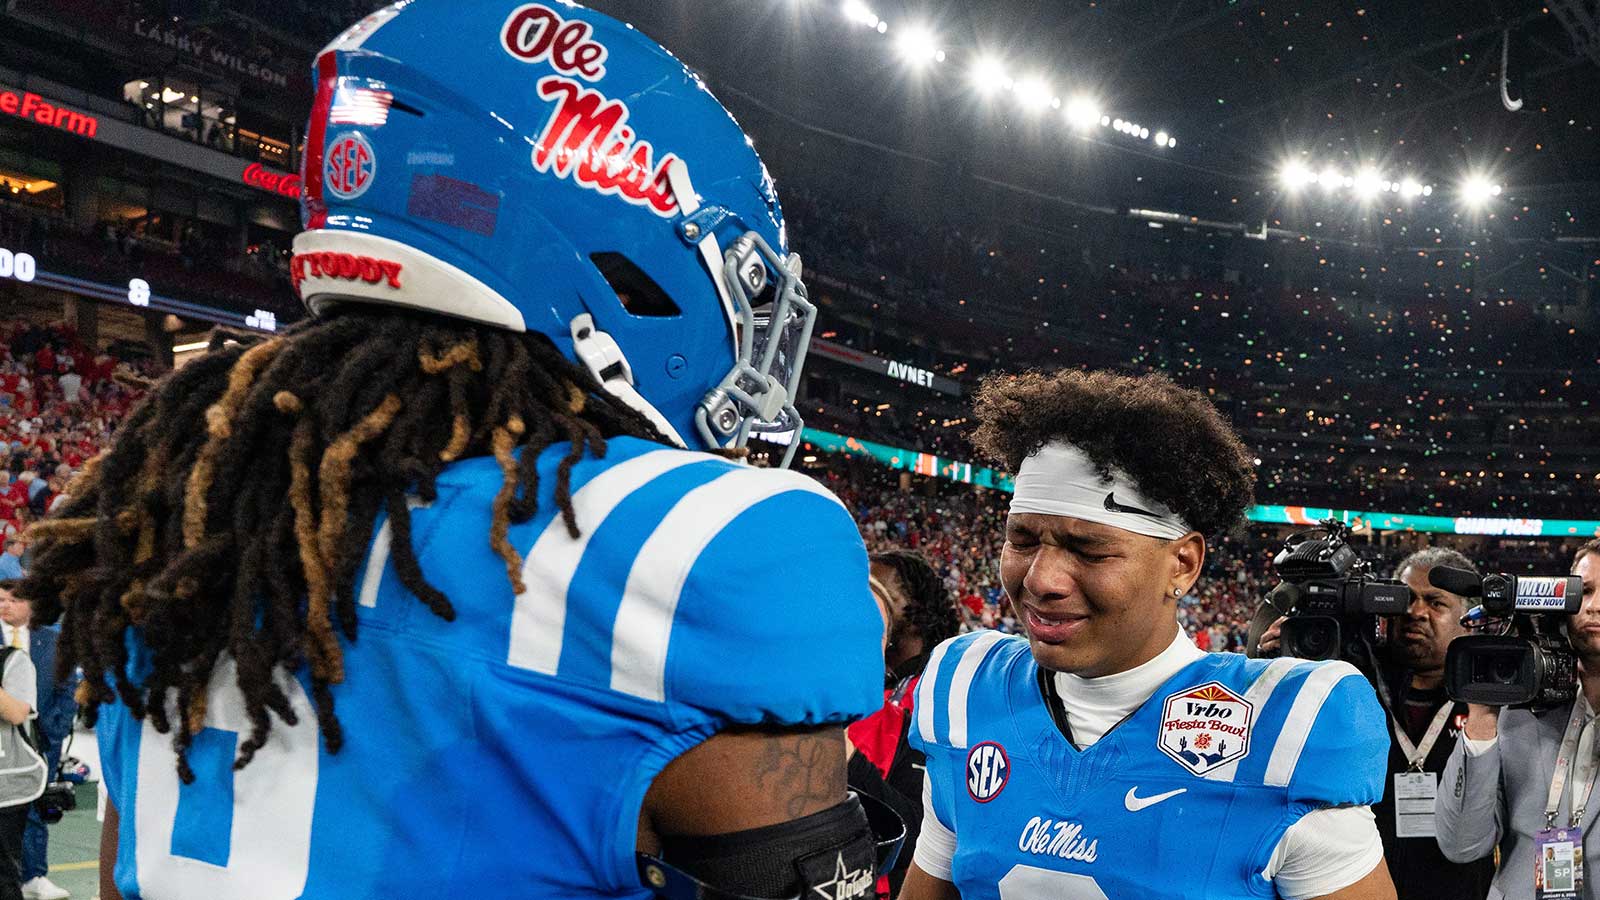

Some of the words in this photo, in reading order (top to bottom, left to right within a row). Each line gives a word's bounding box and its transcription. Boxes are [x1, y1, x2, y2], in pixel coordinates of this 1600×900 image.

[134, 21, 203, 56] LARRY
[211, 46, 288, 87] WILSON
[502, 4, 607, 81] Ole
[21, 91, 98, 138] Farm
[328, 138, 371, 193] SEC
[532, 76, 683, 217] Miss
[888, 360, 935, 388] AVNET
[1519, 580, 1557, 597] WLOX
[1164, 719, 1207, 732] Fiesta
[1207, 719, 1246, 738] Bowl
[1186, 702, 1233, 718] Vrbo
[968, 745, 1007, 799] SEC
[1019, 816, 1051, 854] Ole
[1046, 821, 1098, 863] Miss
[1554, 867, 1570, 878] SP
